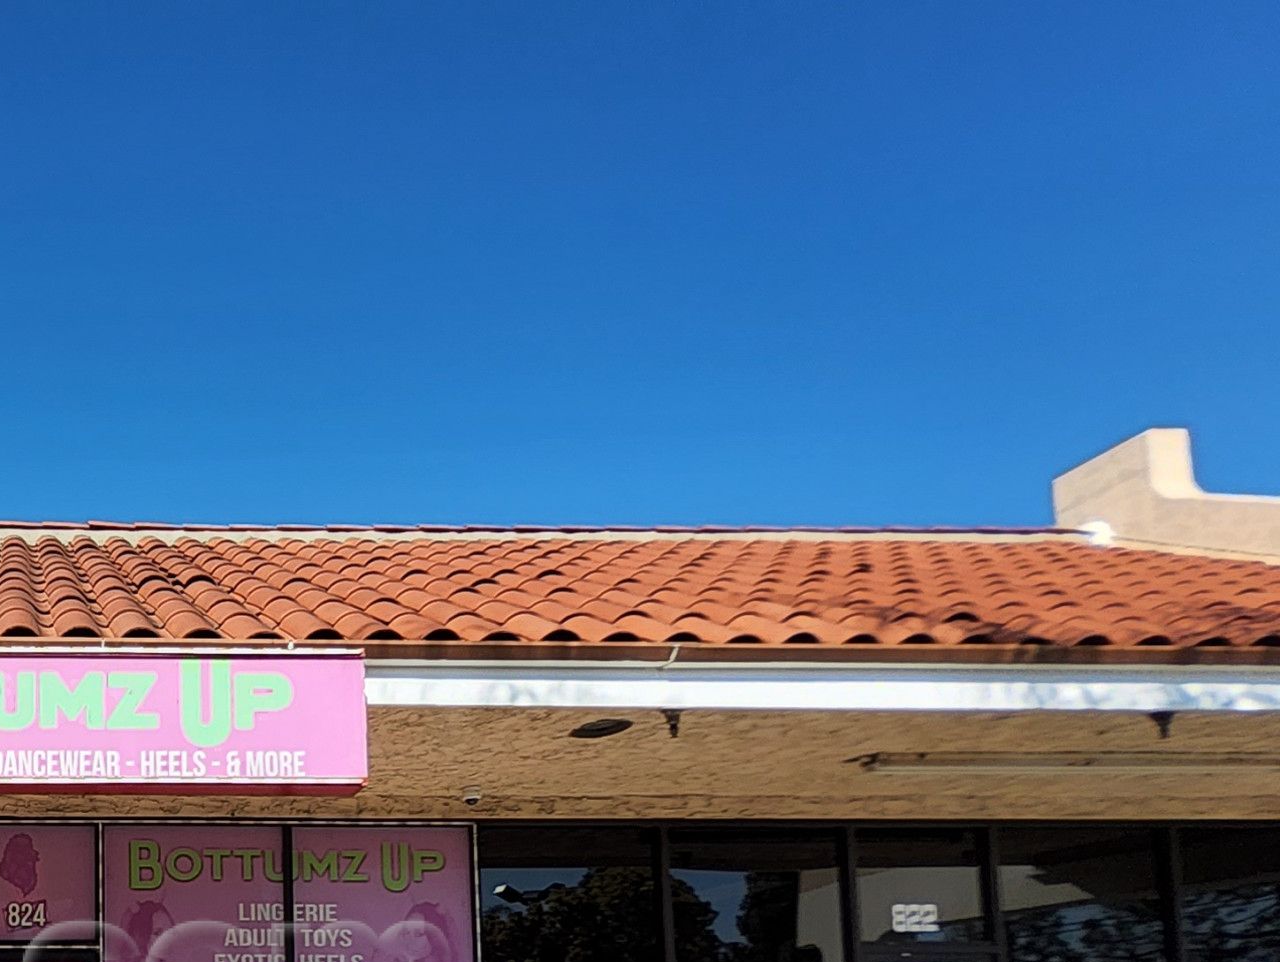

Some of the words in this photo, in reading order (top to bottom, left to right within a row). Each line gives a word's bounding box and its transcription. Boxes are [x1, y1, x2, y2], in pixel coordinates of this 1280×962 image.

[140, 750, 206, 777] HEELS
[225, 750, 241, 777] &
[246, 750, 306, 777] MORE
[8, 903, 46, 927] 824
[238, 903, 338, 922] LINGERIE
[224, 929, 285, 947] ADULT
[301, 929, 352, 947] TOYS
